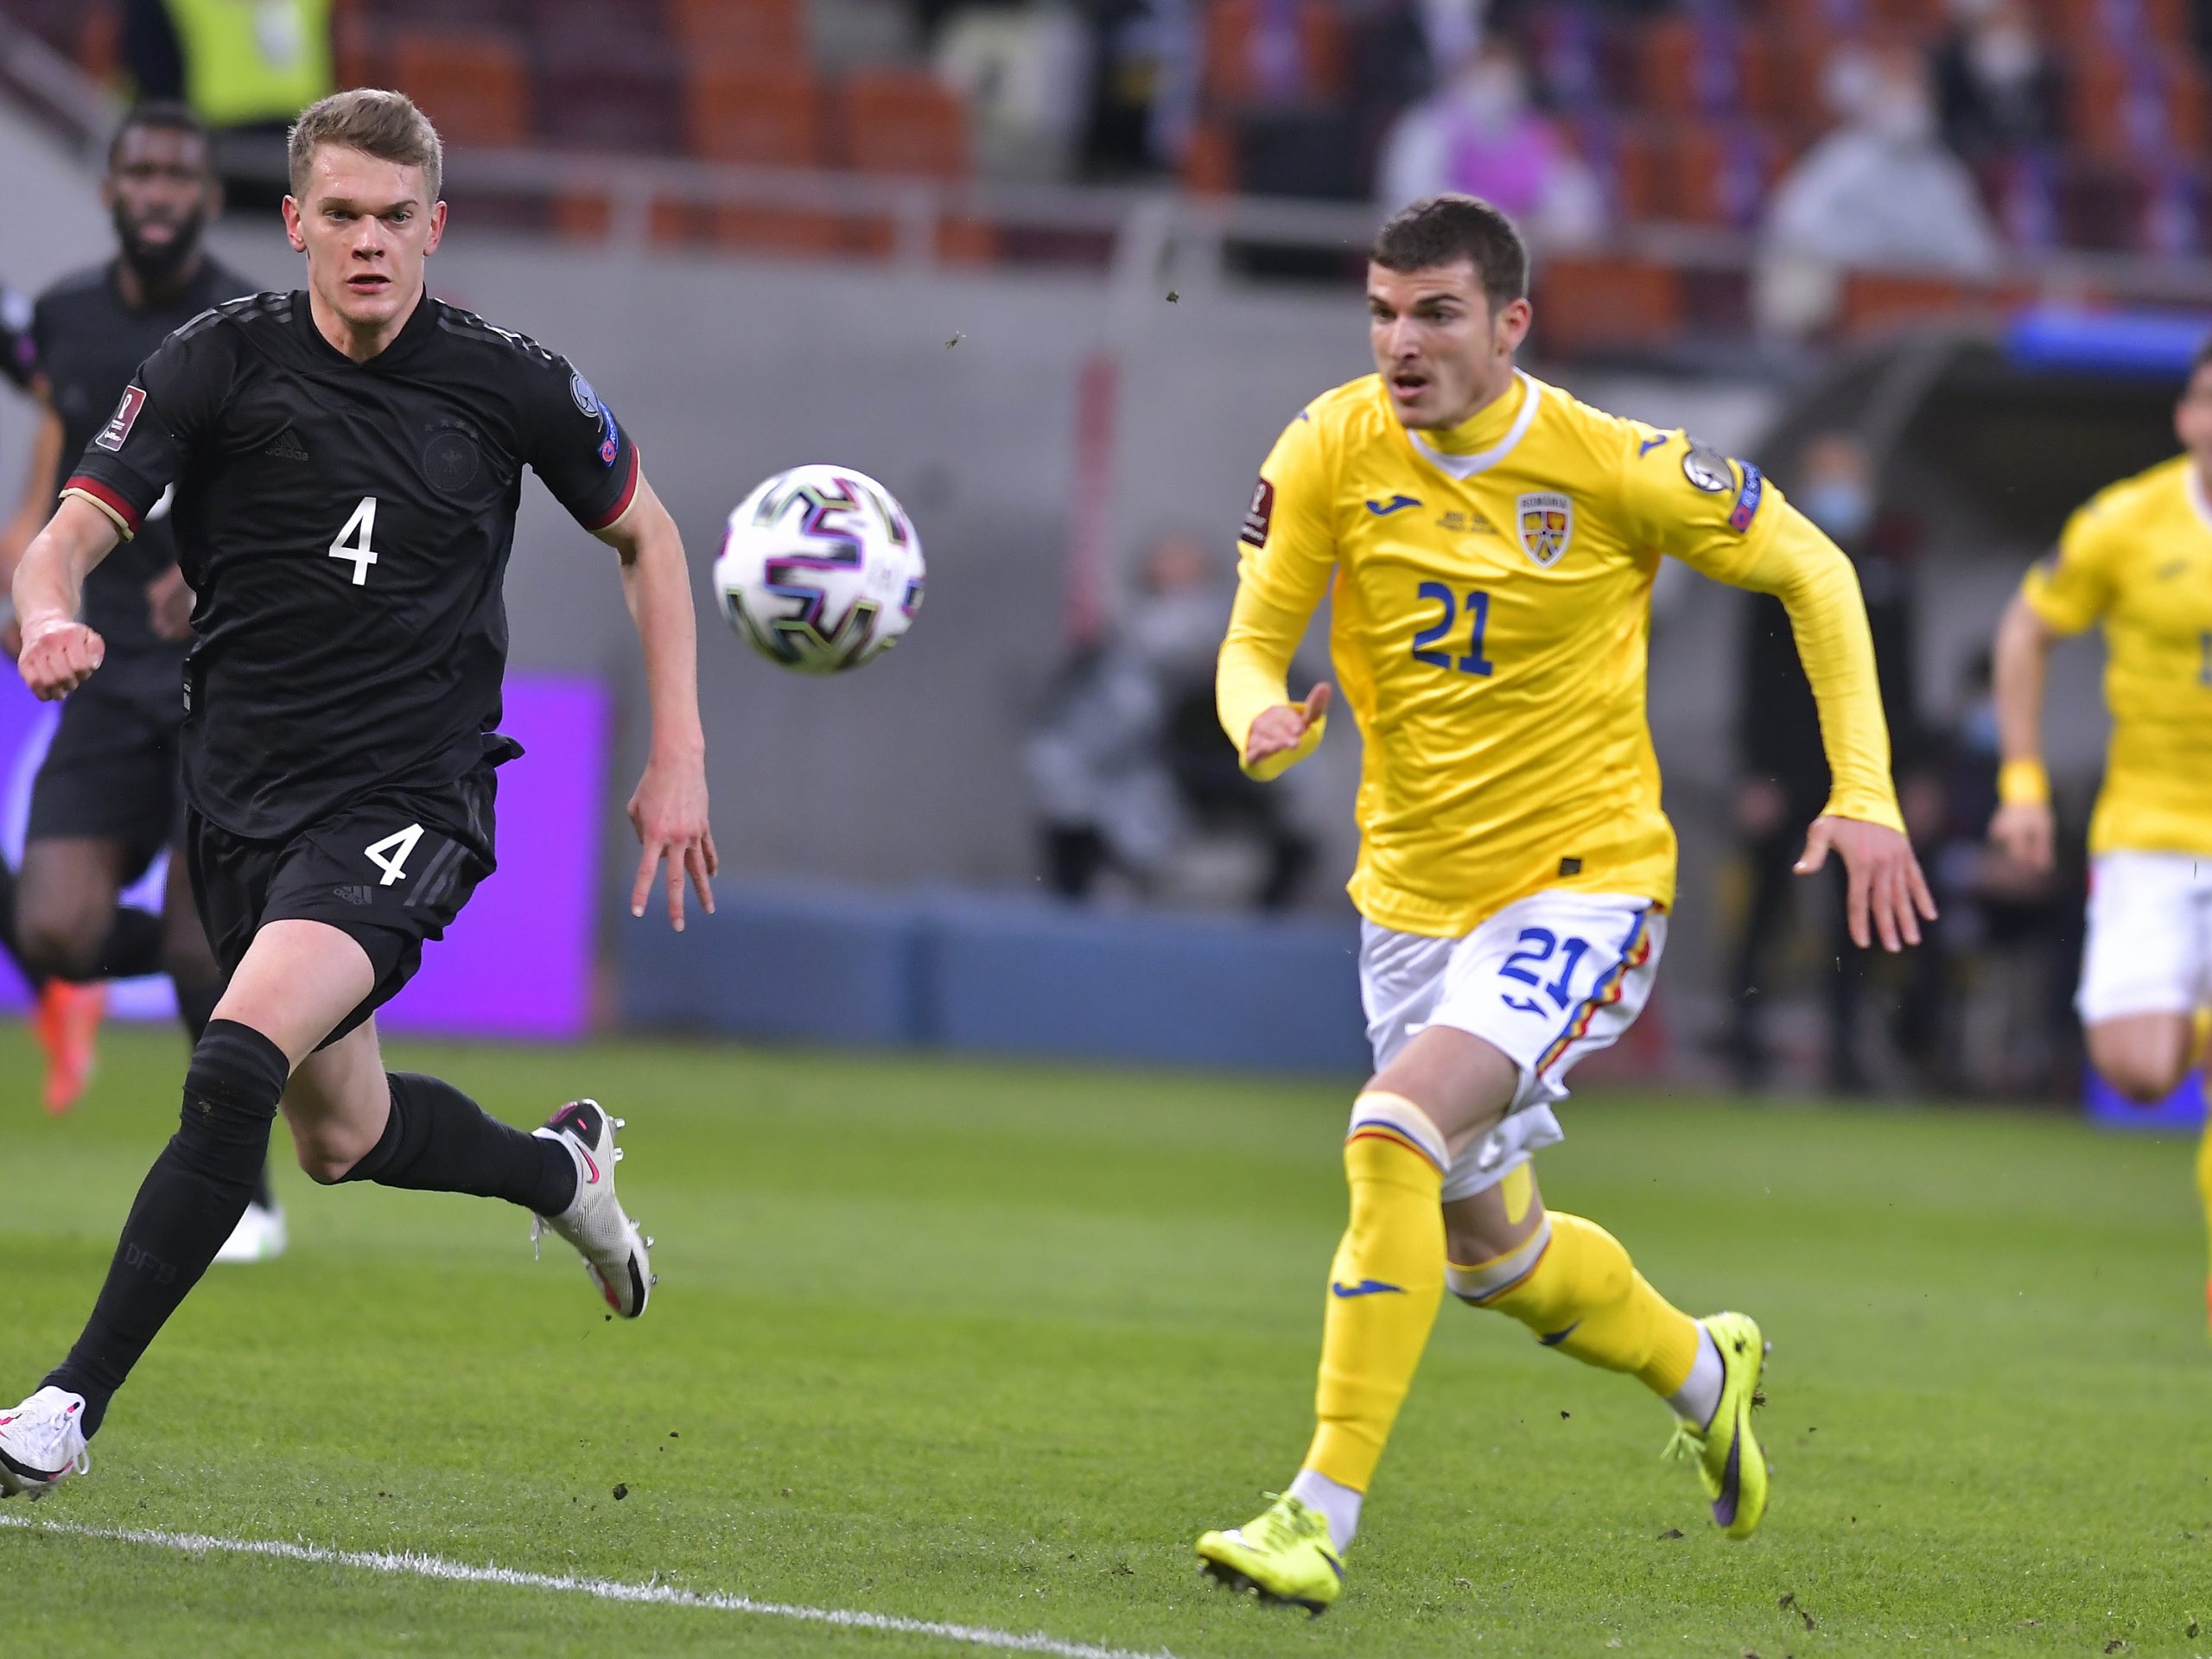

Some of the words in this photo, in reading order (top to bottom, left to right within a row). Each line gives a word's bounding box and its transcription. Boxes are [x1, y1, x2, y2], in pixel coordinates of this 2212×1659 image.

[328, 496, 378, 586] 4
[1413, 582, 1493, 677] 21
[364, 823, 425, 887] 4
[1498, 928, 1588, 1010] 21
[124, 1243, 177, 1285] DFB
